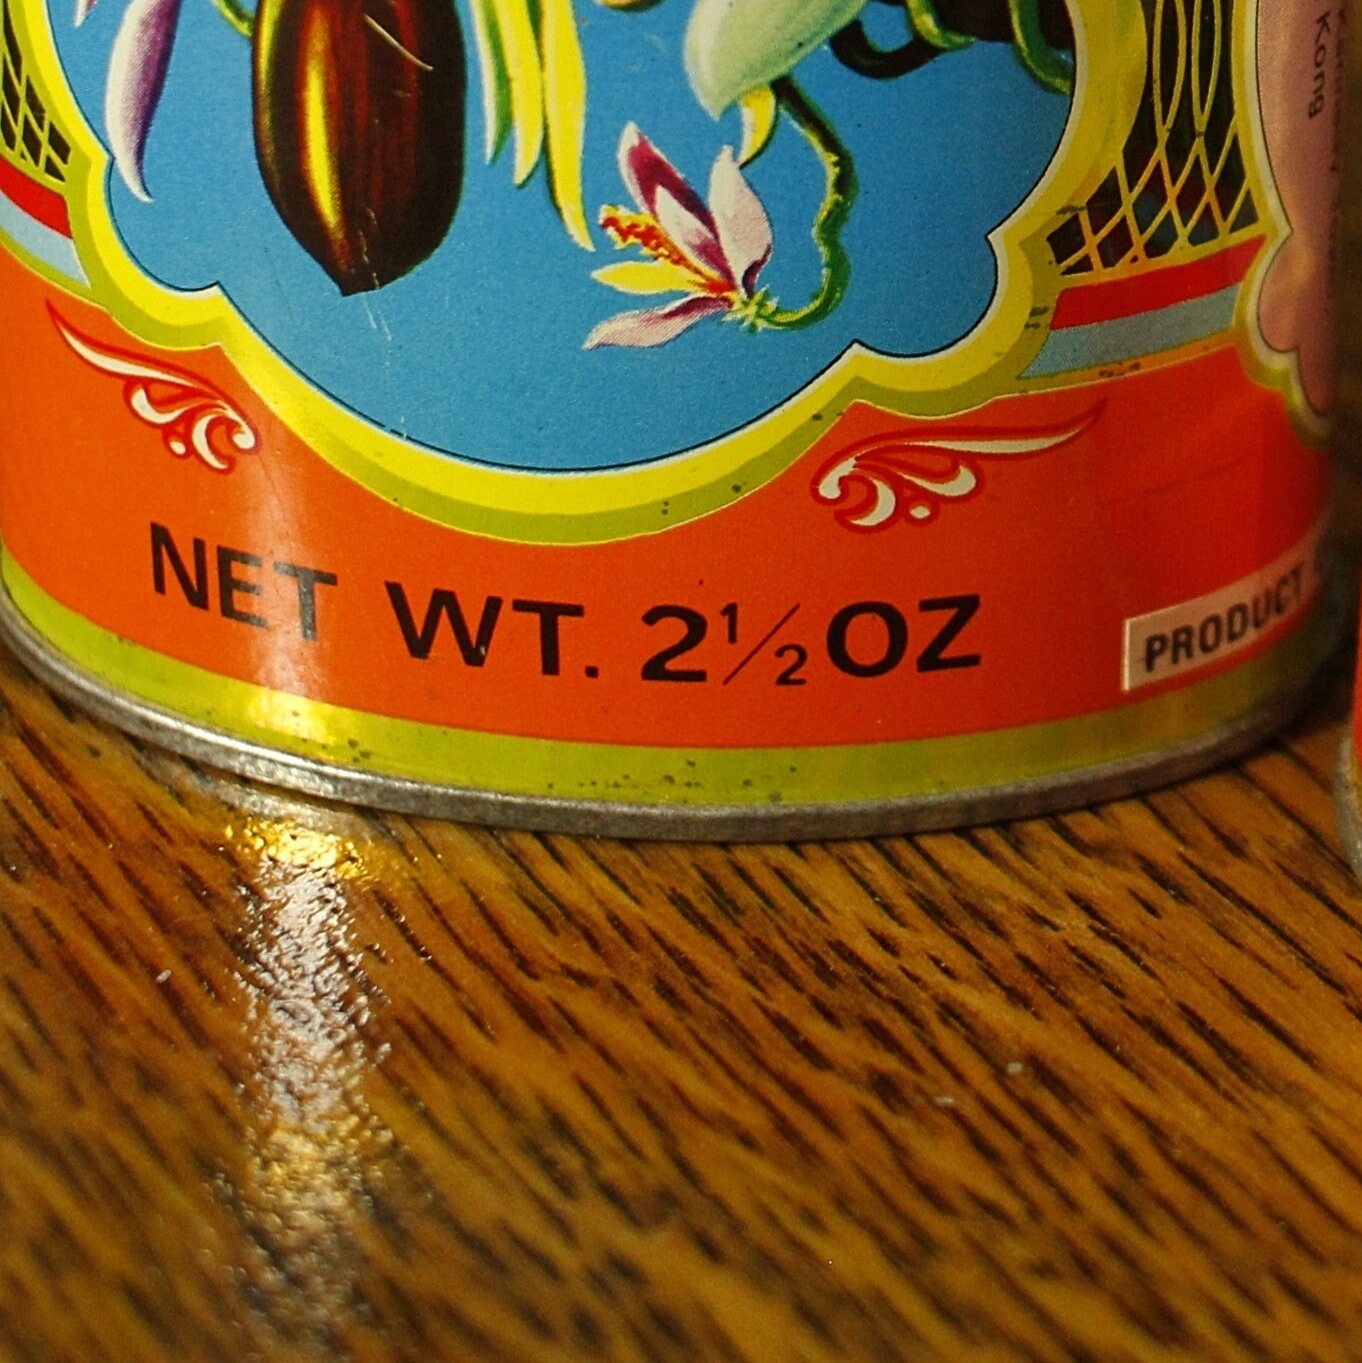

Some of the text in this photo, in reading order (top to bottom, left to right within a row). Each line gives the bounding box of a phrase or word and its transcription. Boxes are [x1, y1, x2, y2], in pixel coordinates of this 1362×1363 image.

[1307, 10, 1332, 120] Kong
[150, 521, 338, 640] NET
[385, 580, 599, 678] WT.
[1145, 560, 1304, 673] PRODUCT
